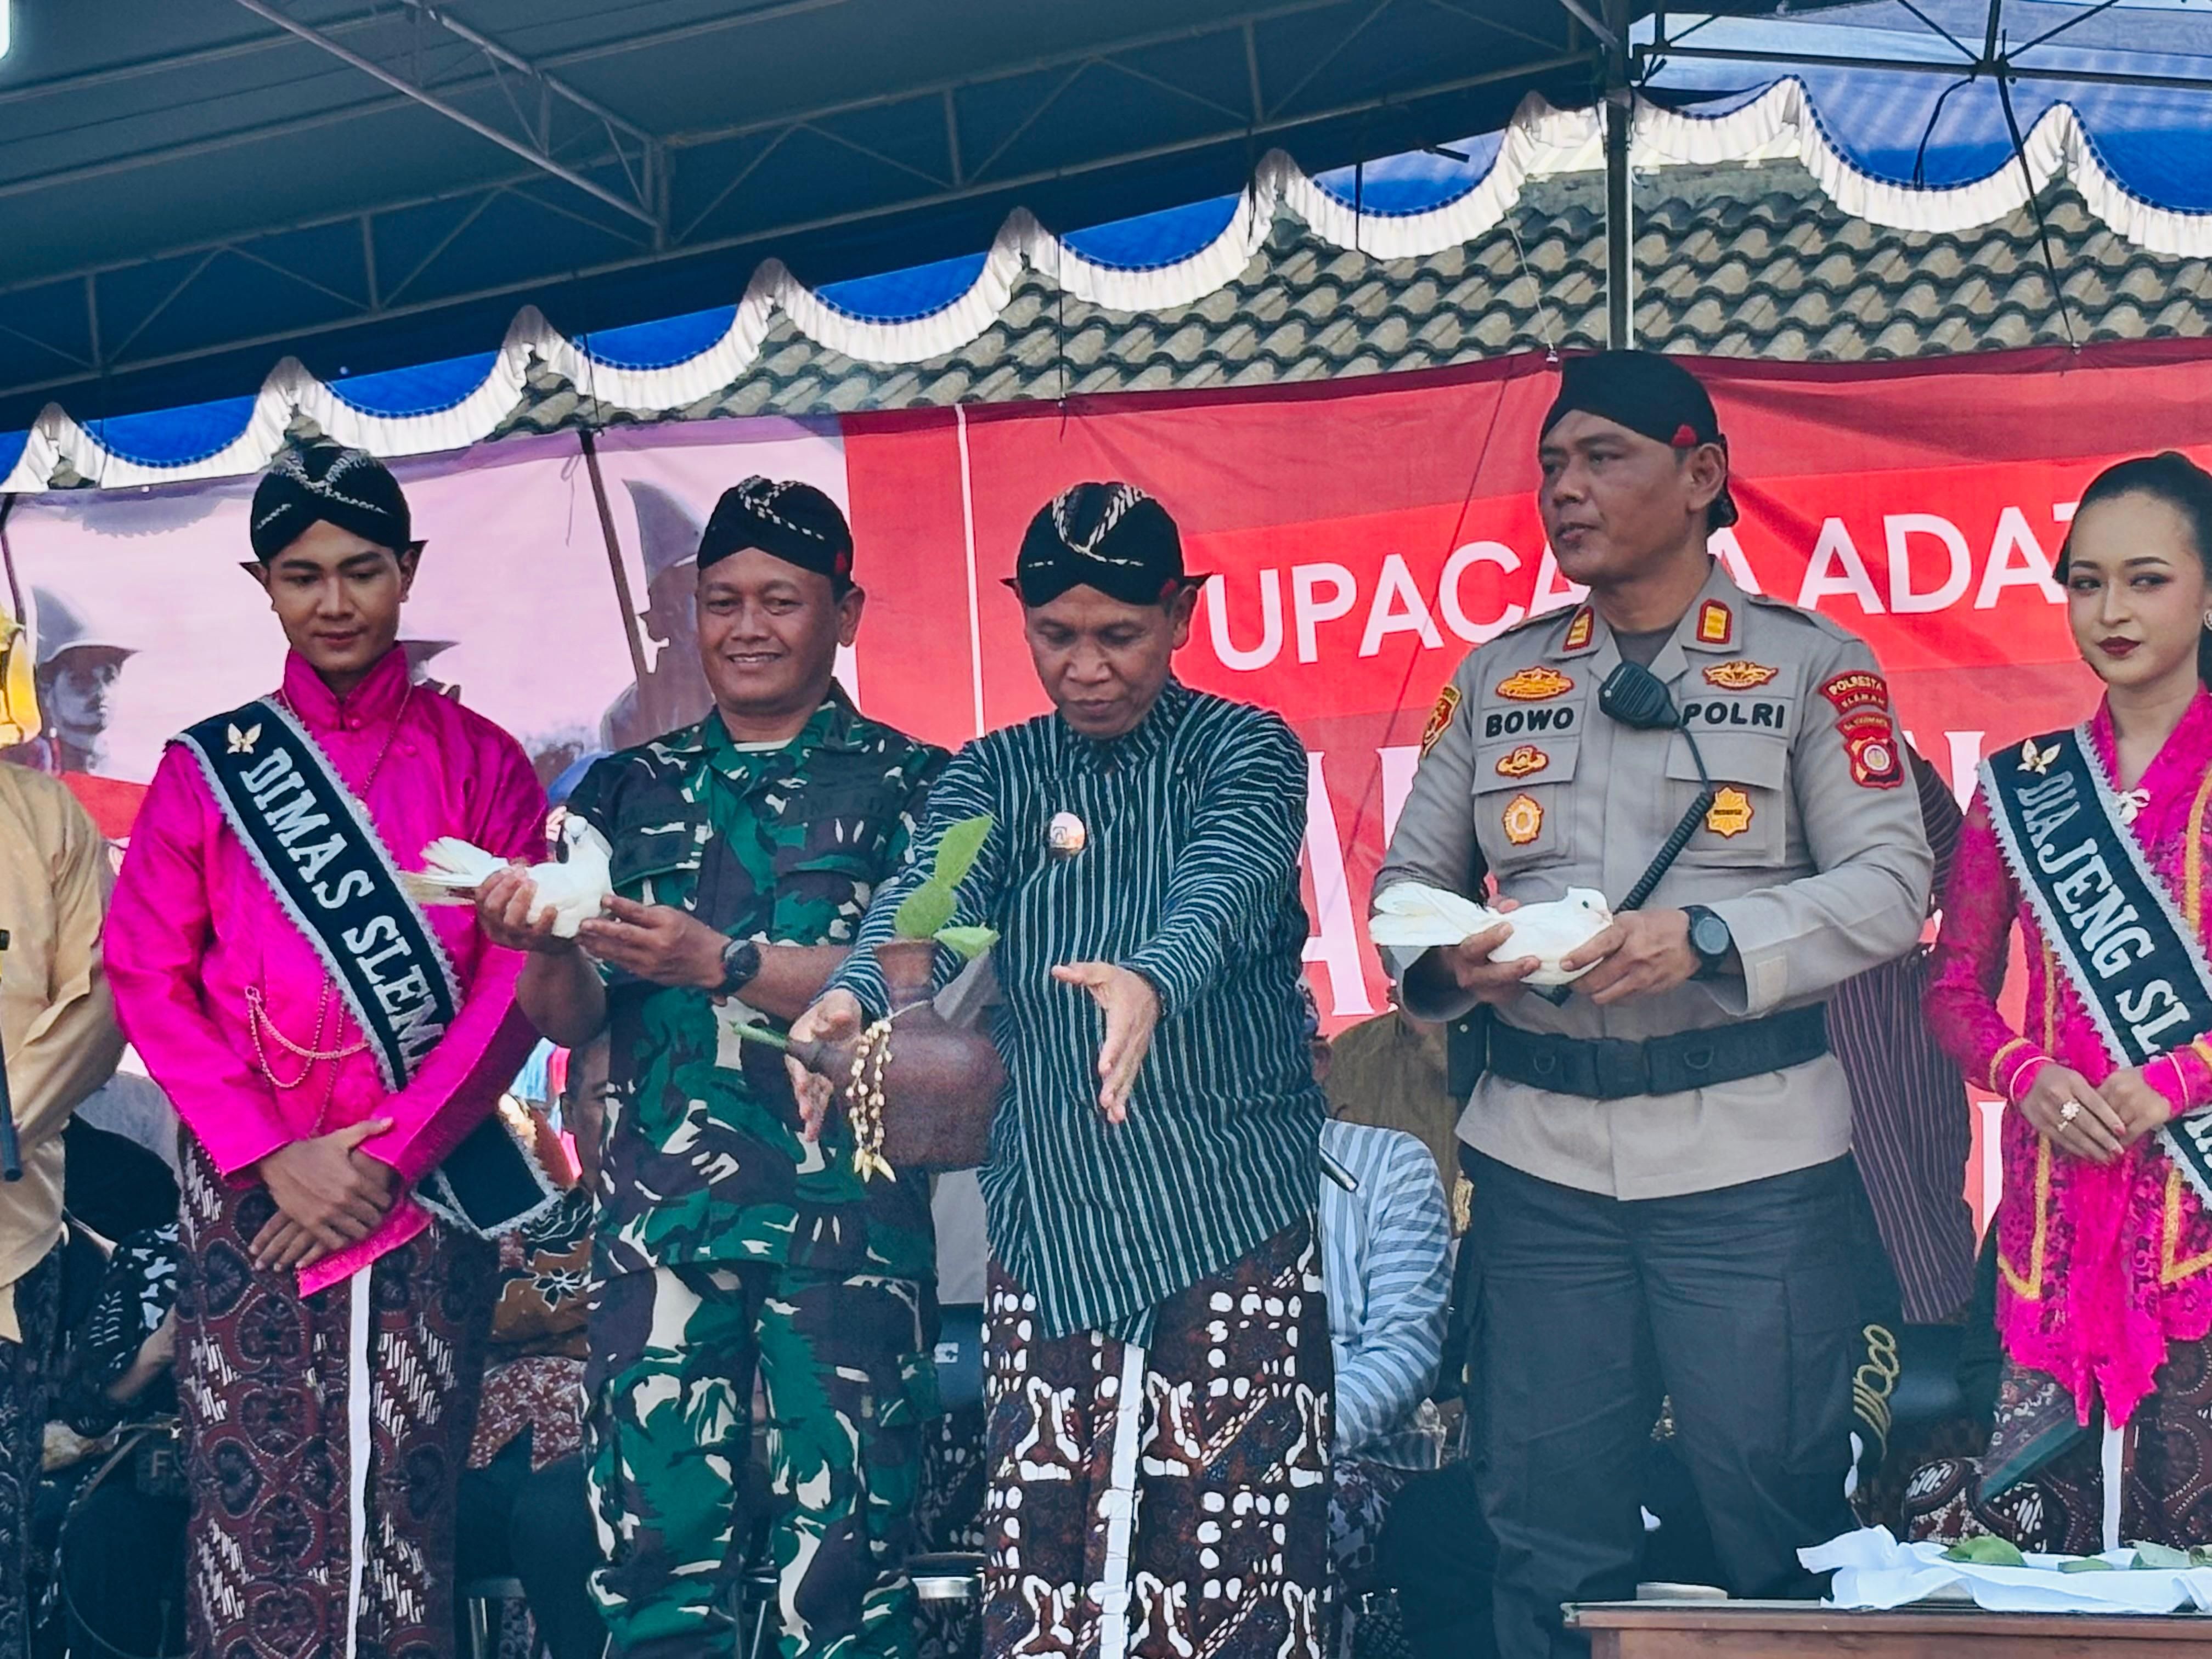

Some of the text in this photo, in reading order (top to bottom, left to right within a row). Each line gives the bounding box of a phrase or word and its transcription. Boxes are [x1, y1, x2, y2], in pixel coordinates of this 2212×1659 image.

[1797, 501, 2080, 614] ADA
[1828, 675, 1883, 696] POLRESTA
[1485, 707, 1574, 738] BOWO
[1681, 702, 1785, 729] POLRI
[240, 747, 444, 1076] DIMAS SLEM
[2115, 979, 2191, 1055] SL
